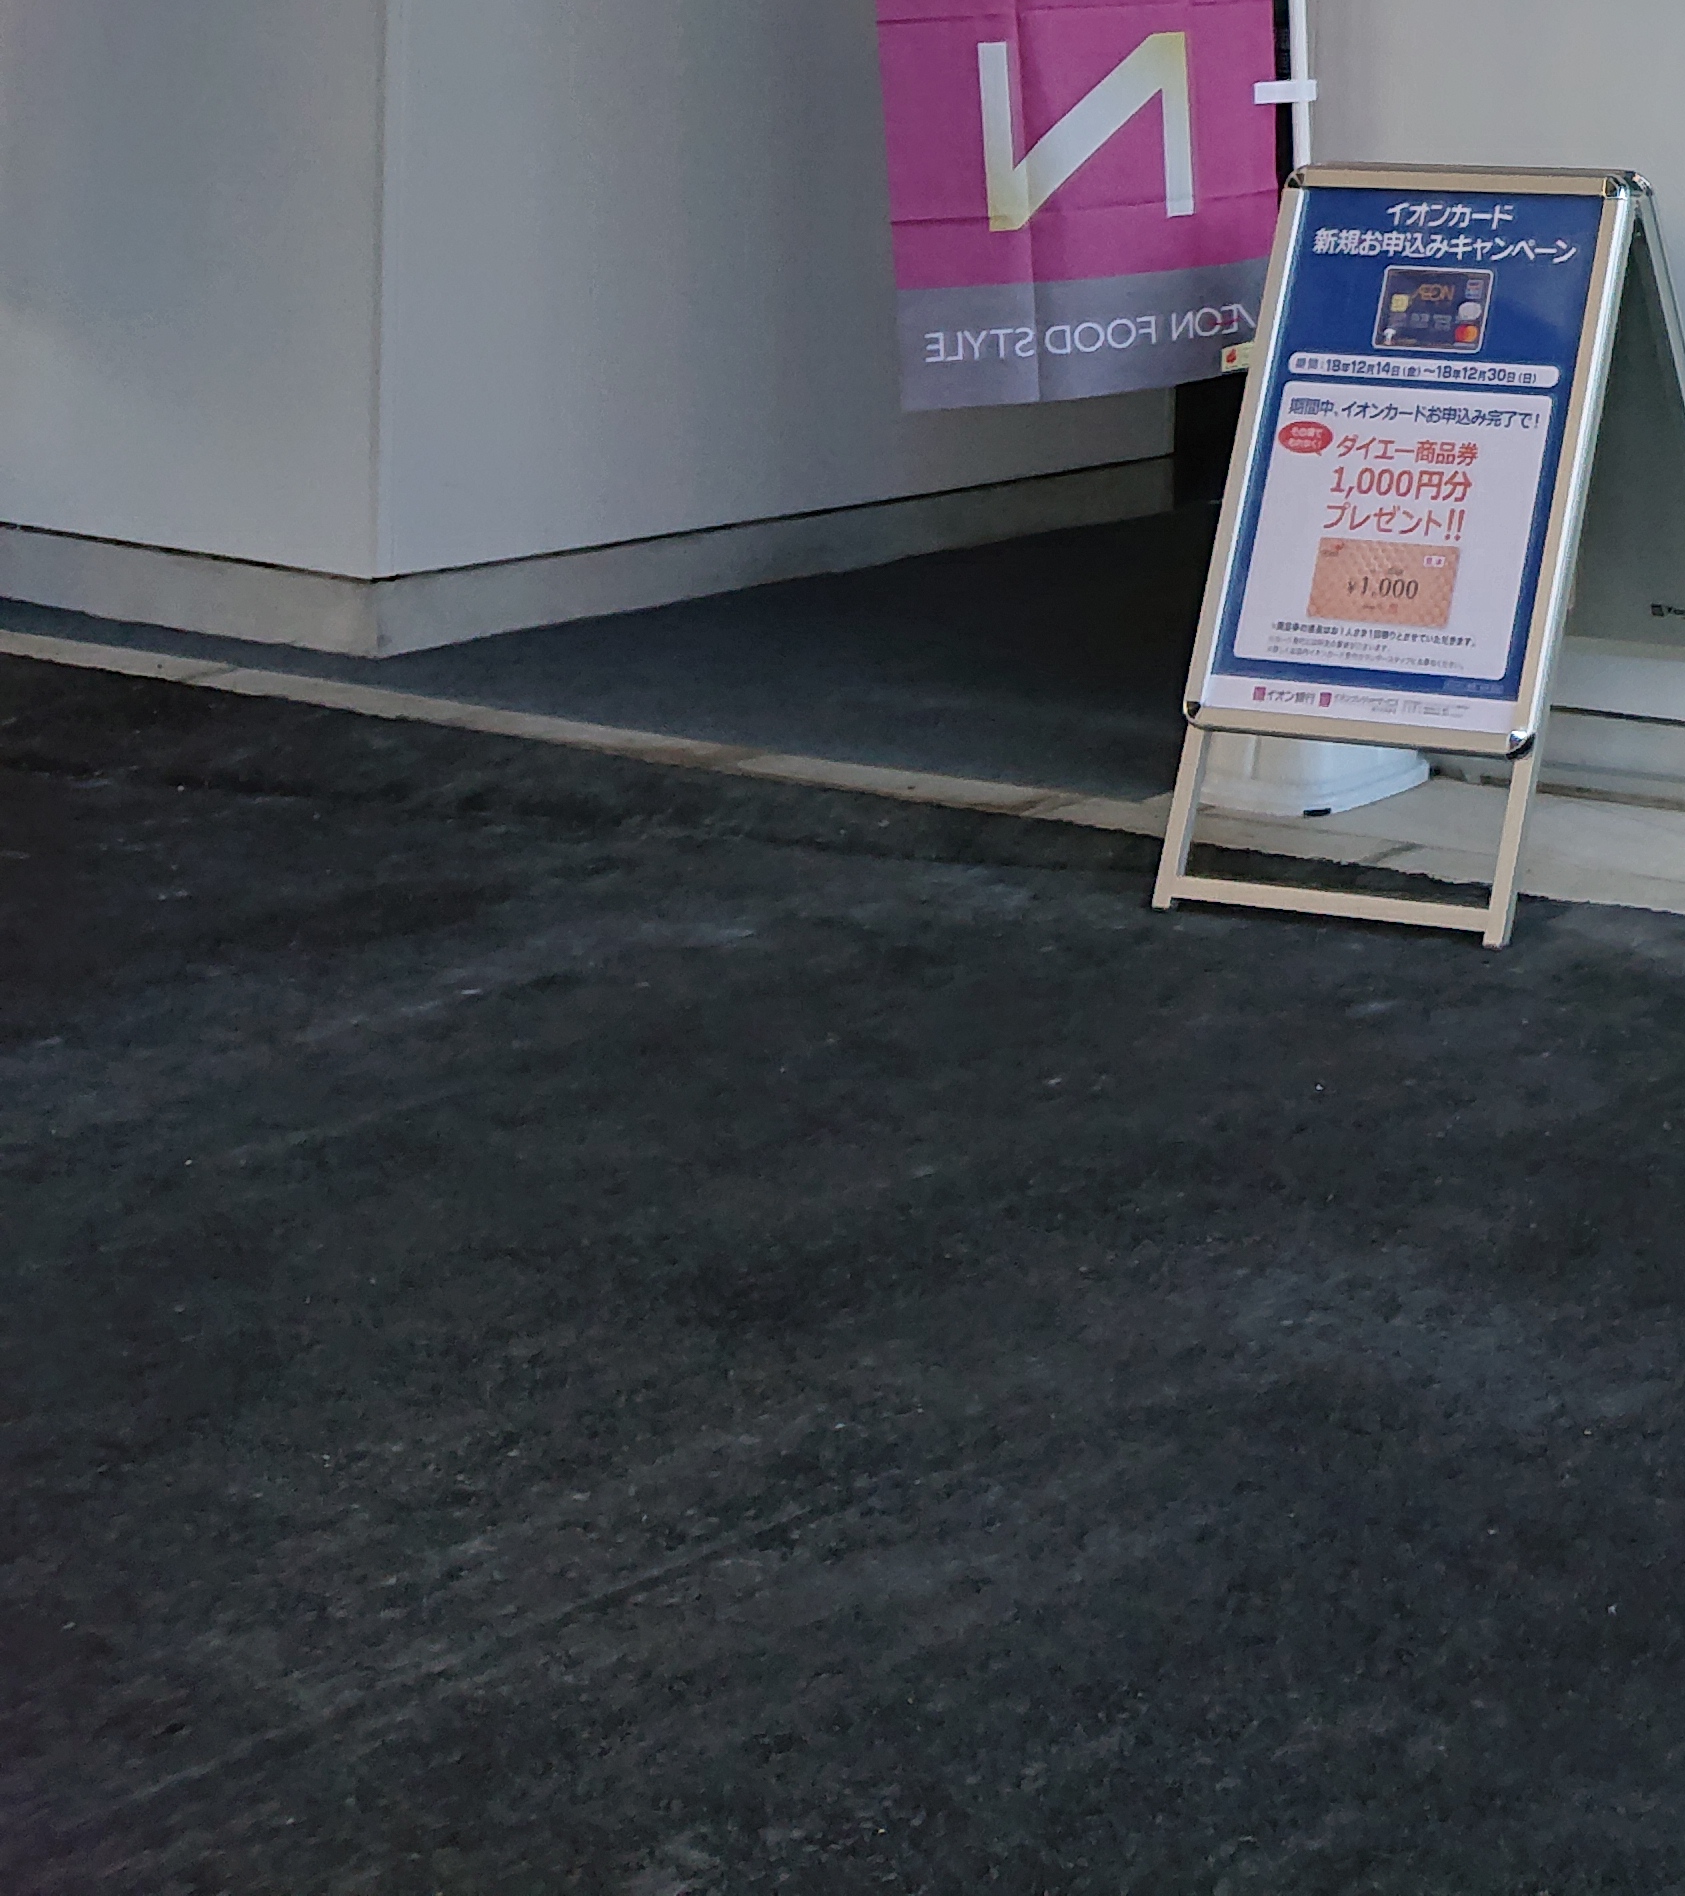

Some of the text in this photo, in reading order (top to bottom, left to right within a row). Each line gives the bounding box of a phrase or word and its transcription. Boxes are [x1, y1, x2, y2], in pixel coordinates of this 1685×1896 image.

[1386, 203, 1514, 230] イオンカード
[1312, 227, 1577, 264] 新規お申込みキャンペーン
[1336, 434, 1479, 466] ダイエー商品券
[1329, 465, 1473, 502] 1,000円分
[1323, 501, 1465, 541] プレゼント!!
